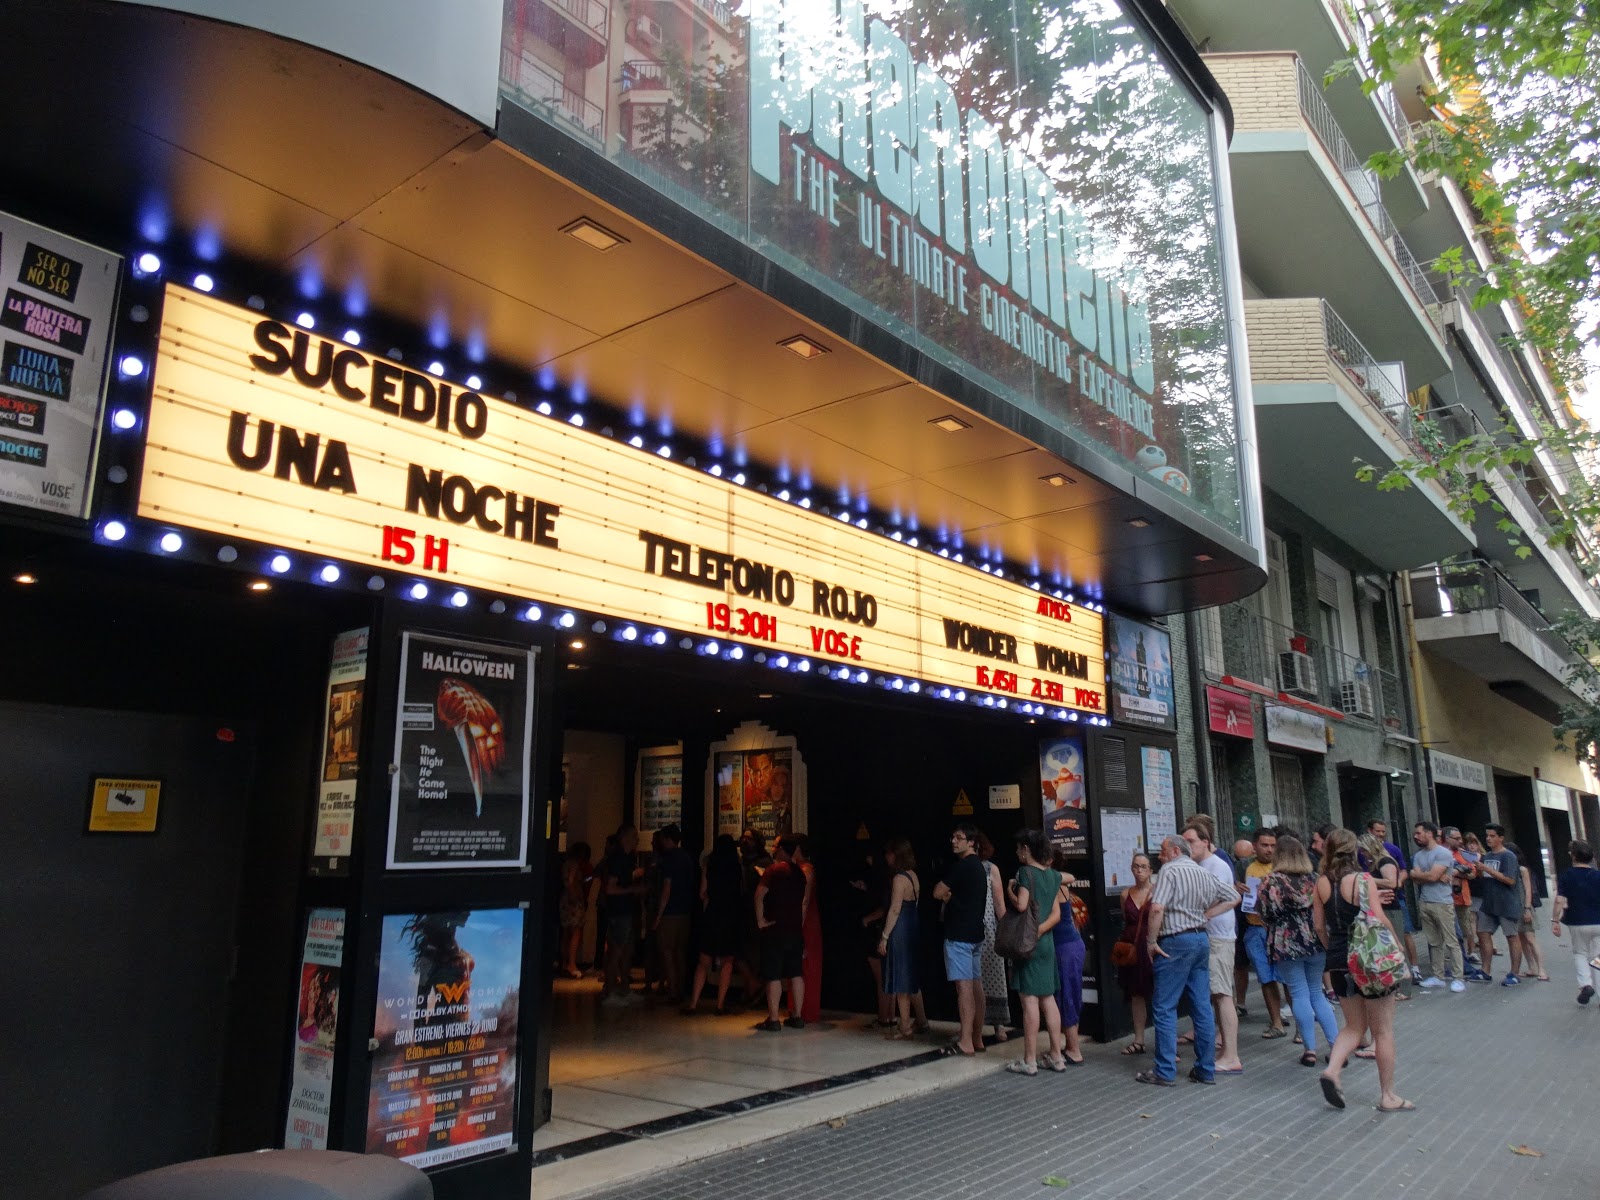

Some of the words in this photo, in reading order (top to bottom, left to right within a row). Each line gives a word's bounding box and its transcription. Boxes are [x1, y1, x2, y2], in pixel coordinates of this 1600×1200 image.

[36, 251, 58, 274] SER
[61, 262, 71, 278] O
[27, 266, 46, 287] NO
[48, 274, 70, 297] SER
[792, 142, 841, 228] THE
[858, 191, 969, 316] ULTIMATE
[979, 282, 1072, 385] CINEMATIC
[1078, 353, 1155, 442] EXPERIENCE
[8, 298, 22, 313] LA
[23, 299, 83, 336] PANTERA
[25, 315, 61, 343] ROSA
[18, 348, 60, 376] LUNA
[9, 365, 64, 395] NUEVA
[249, 320, 488, 440] SUCEDIO
[41, 481, 71, 499] VOSE
[226, 410, 357, 495] UNA
[404, 463, 561, 549] NOCHE
[638, 529, 795, 607] TELEFONO
[812, 579, 878, 628] ROJO
[1036, 595, 1072, 623] ATMOS
[706, 601, 777, 643] 19.30H
[810, 625, 863, 661] VOSE
[942, 617, 1019, 664] WONDER
[1034, 641, 1089, 681] WOMAN
[422, 651, 515, 680] HALLOWEEN
[1074, 686, 1102, 710] VOSE
[420, 744, 436, 755] The
[420, 756, 444, 768] Night
[419, 767, 432, 777] He
[419, 777, 445, 788] Came
[418, 788, 448, 799] Home!
[395, 1027, 413, 1046] GRAN
[414, 1023, 444, 1043] ESTRENO:
[445, 1021, 471, 1039] VIERNES
